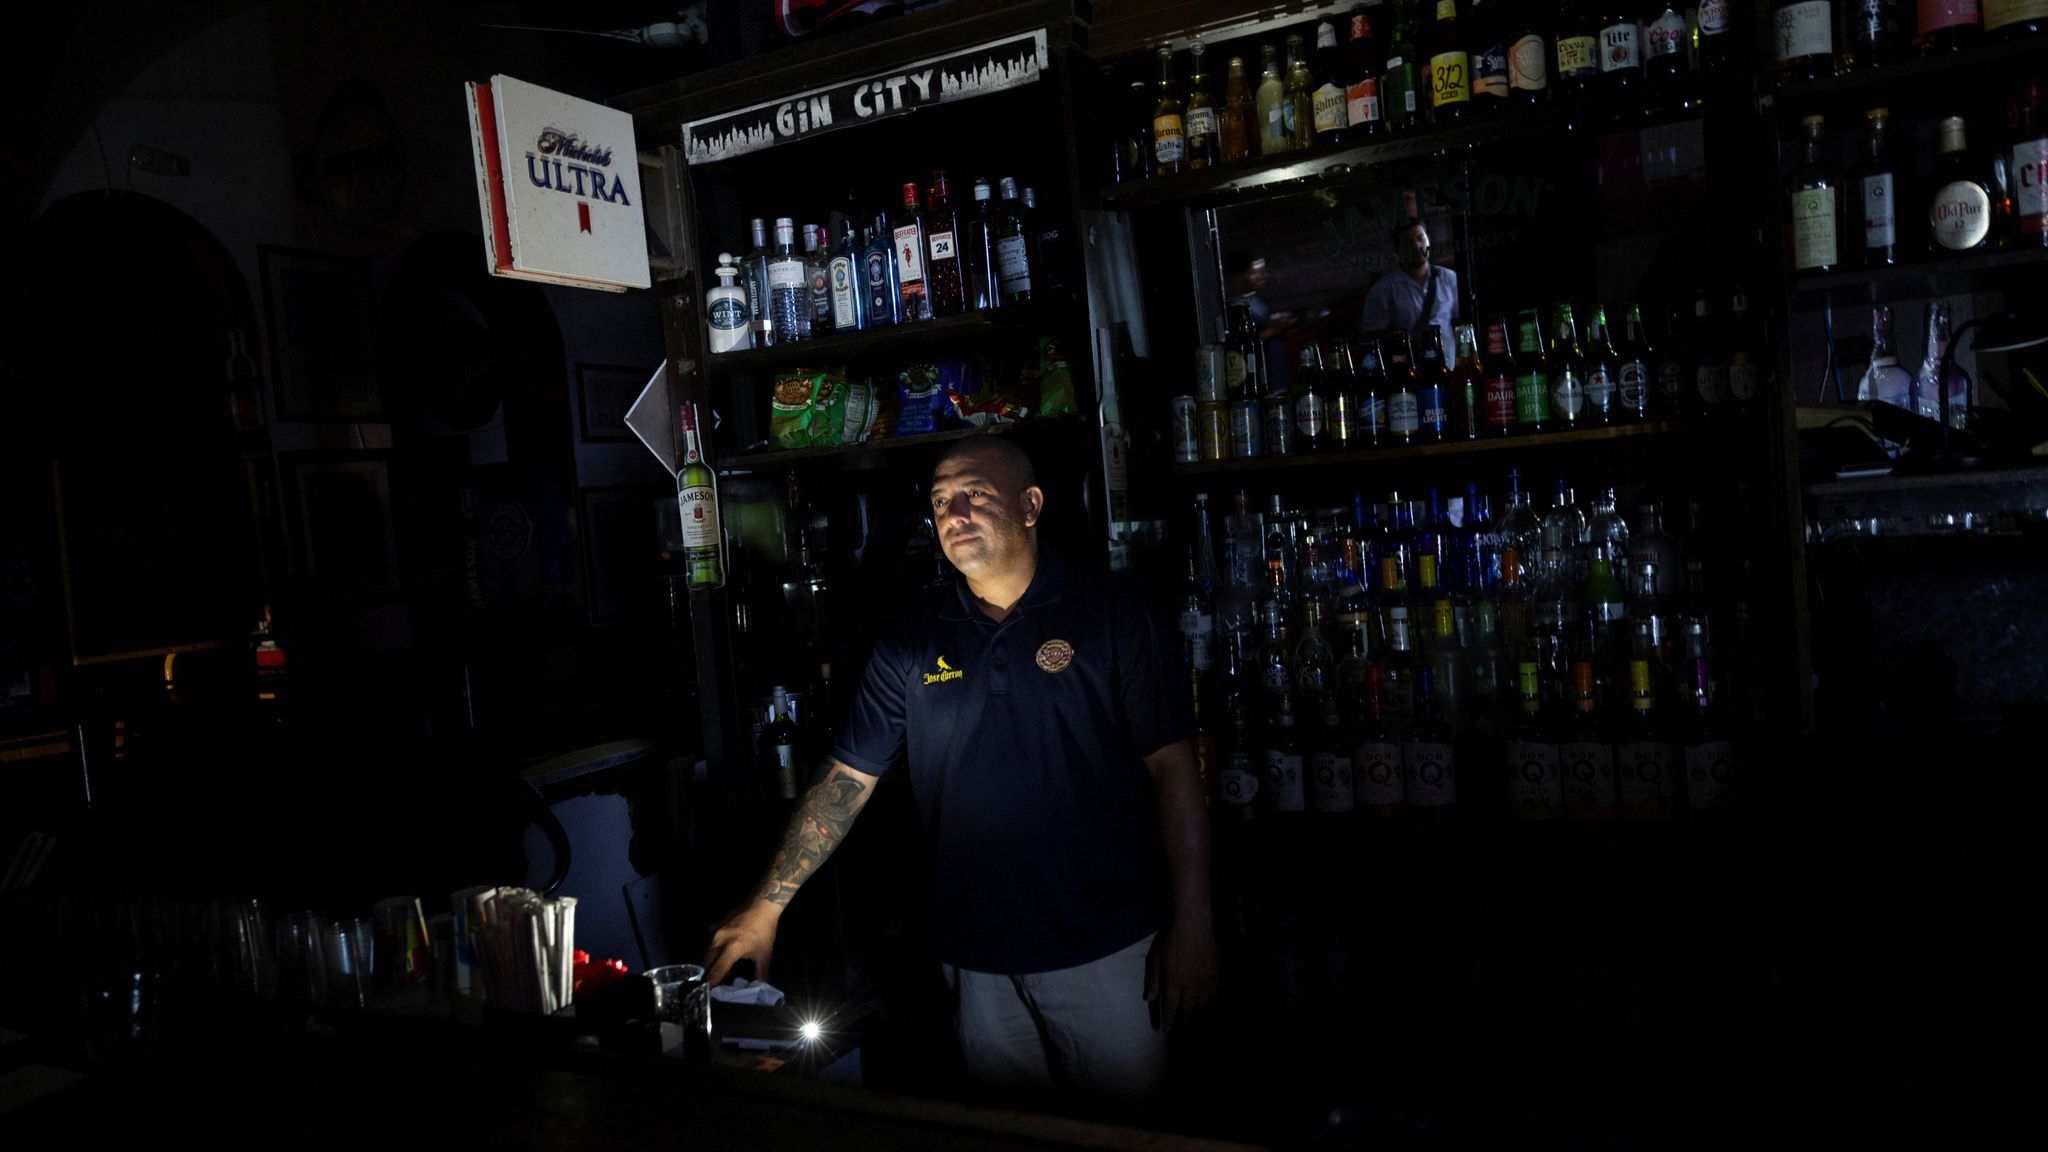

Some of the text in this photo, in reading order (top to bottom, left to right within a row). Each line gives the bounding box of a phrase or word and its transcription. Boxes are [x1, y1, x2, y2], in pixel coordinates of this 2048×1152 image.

[1606, 31, 1630, 47] Lite
[1435, 64, 1465, 93] 312
[1314, 93, 1346, 115] Shiner
[1154, 127, 1182, 142] Corona
[537, 127, 612, 167] Michelob
[525, 152, 631, 207] ULTRA
[1937, 203, 1959, 221] Old
[894, 227, 916, 239] BEEFEATER
[935, 241, 949, 254] 24
[712, 310, 742, 320] WINT
[1487, 390, 1516, 402] DAUR
[1422, 414, 1449, 424] LIGHT
[680, 491, 714, 507] JAMESON
[923, 673, 940, 685] Jose
